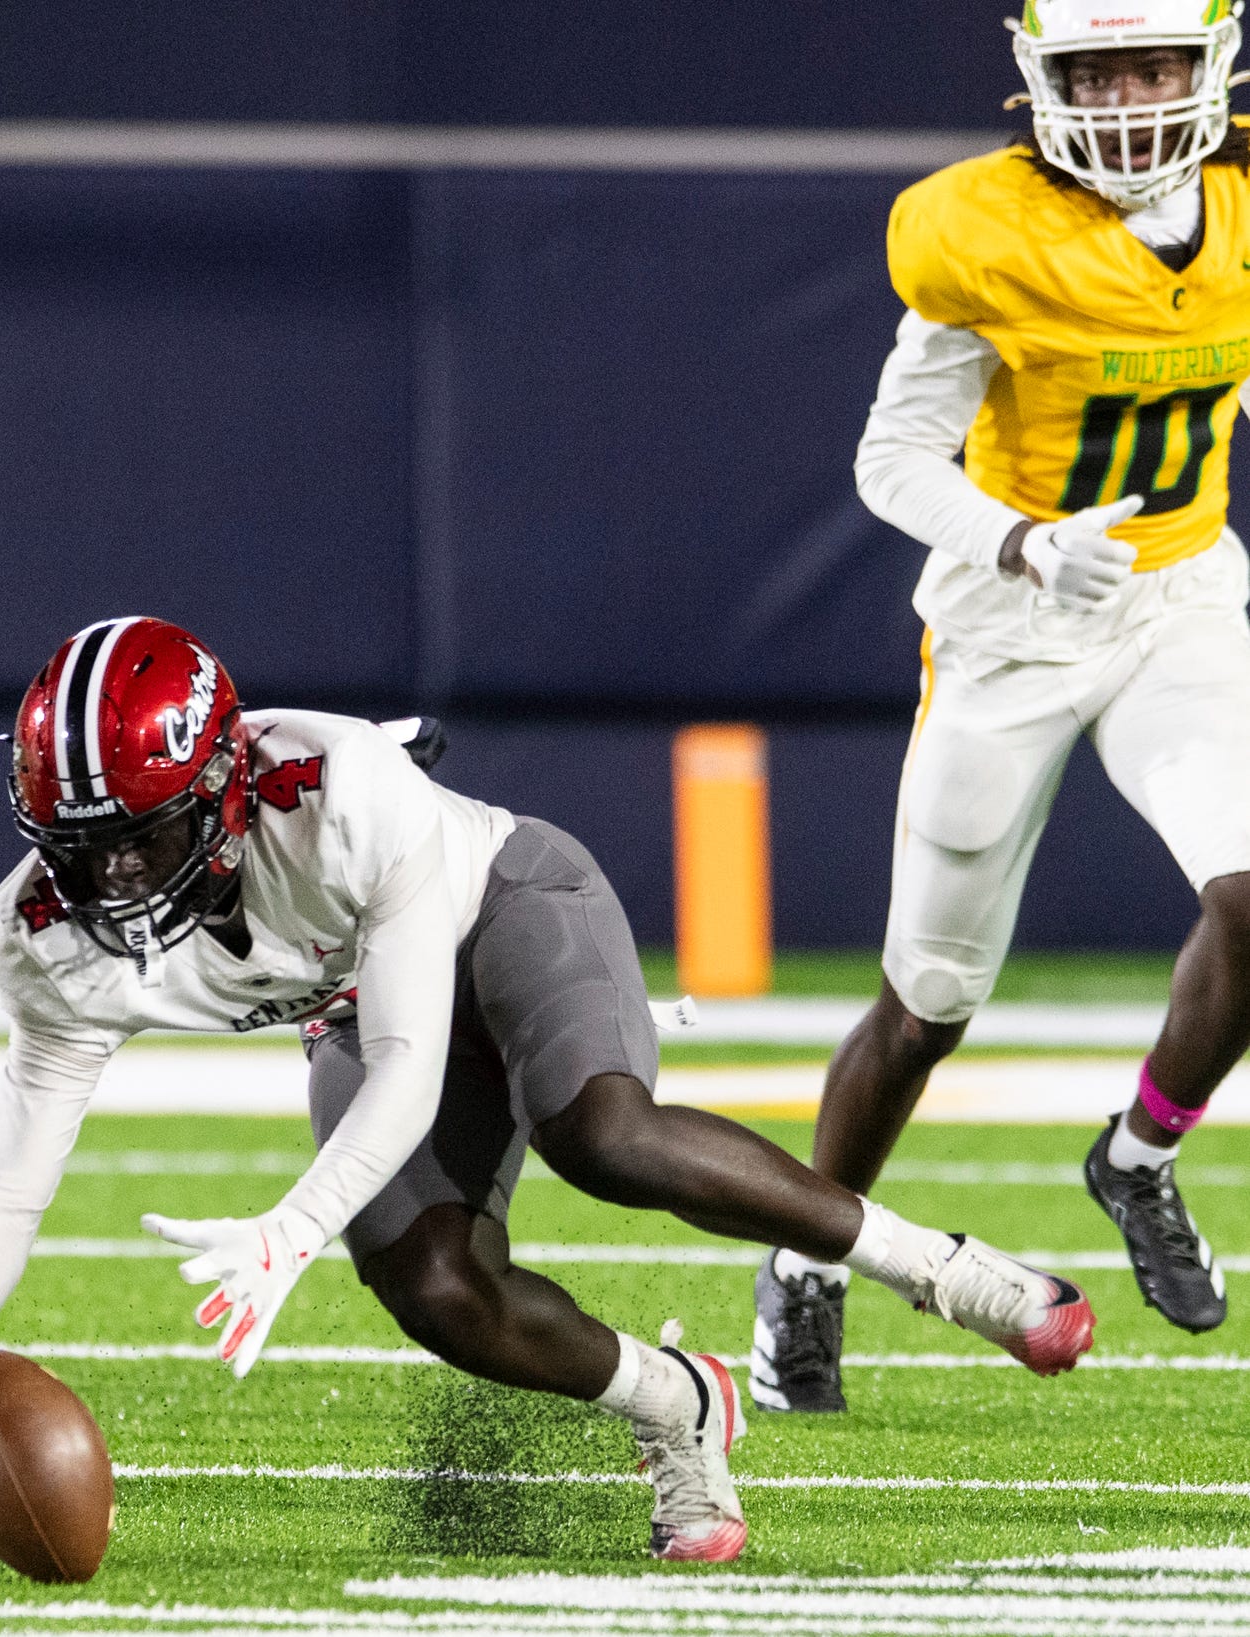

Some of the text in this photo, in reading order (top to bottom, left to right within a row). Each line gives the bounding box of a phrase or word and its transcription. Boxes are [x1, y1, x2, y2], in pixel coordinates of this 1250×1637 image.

[1090, 16, 1147, 28] Riddell
[1102, 338, 1249, 383] WOLVERINES
[1057, 381, 1236, 517] 10
[255, 754, 324, 814] 4
[56, 799, 117, 820] Riddell
